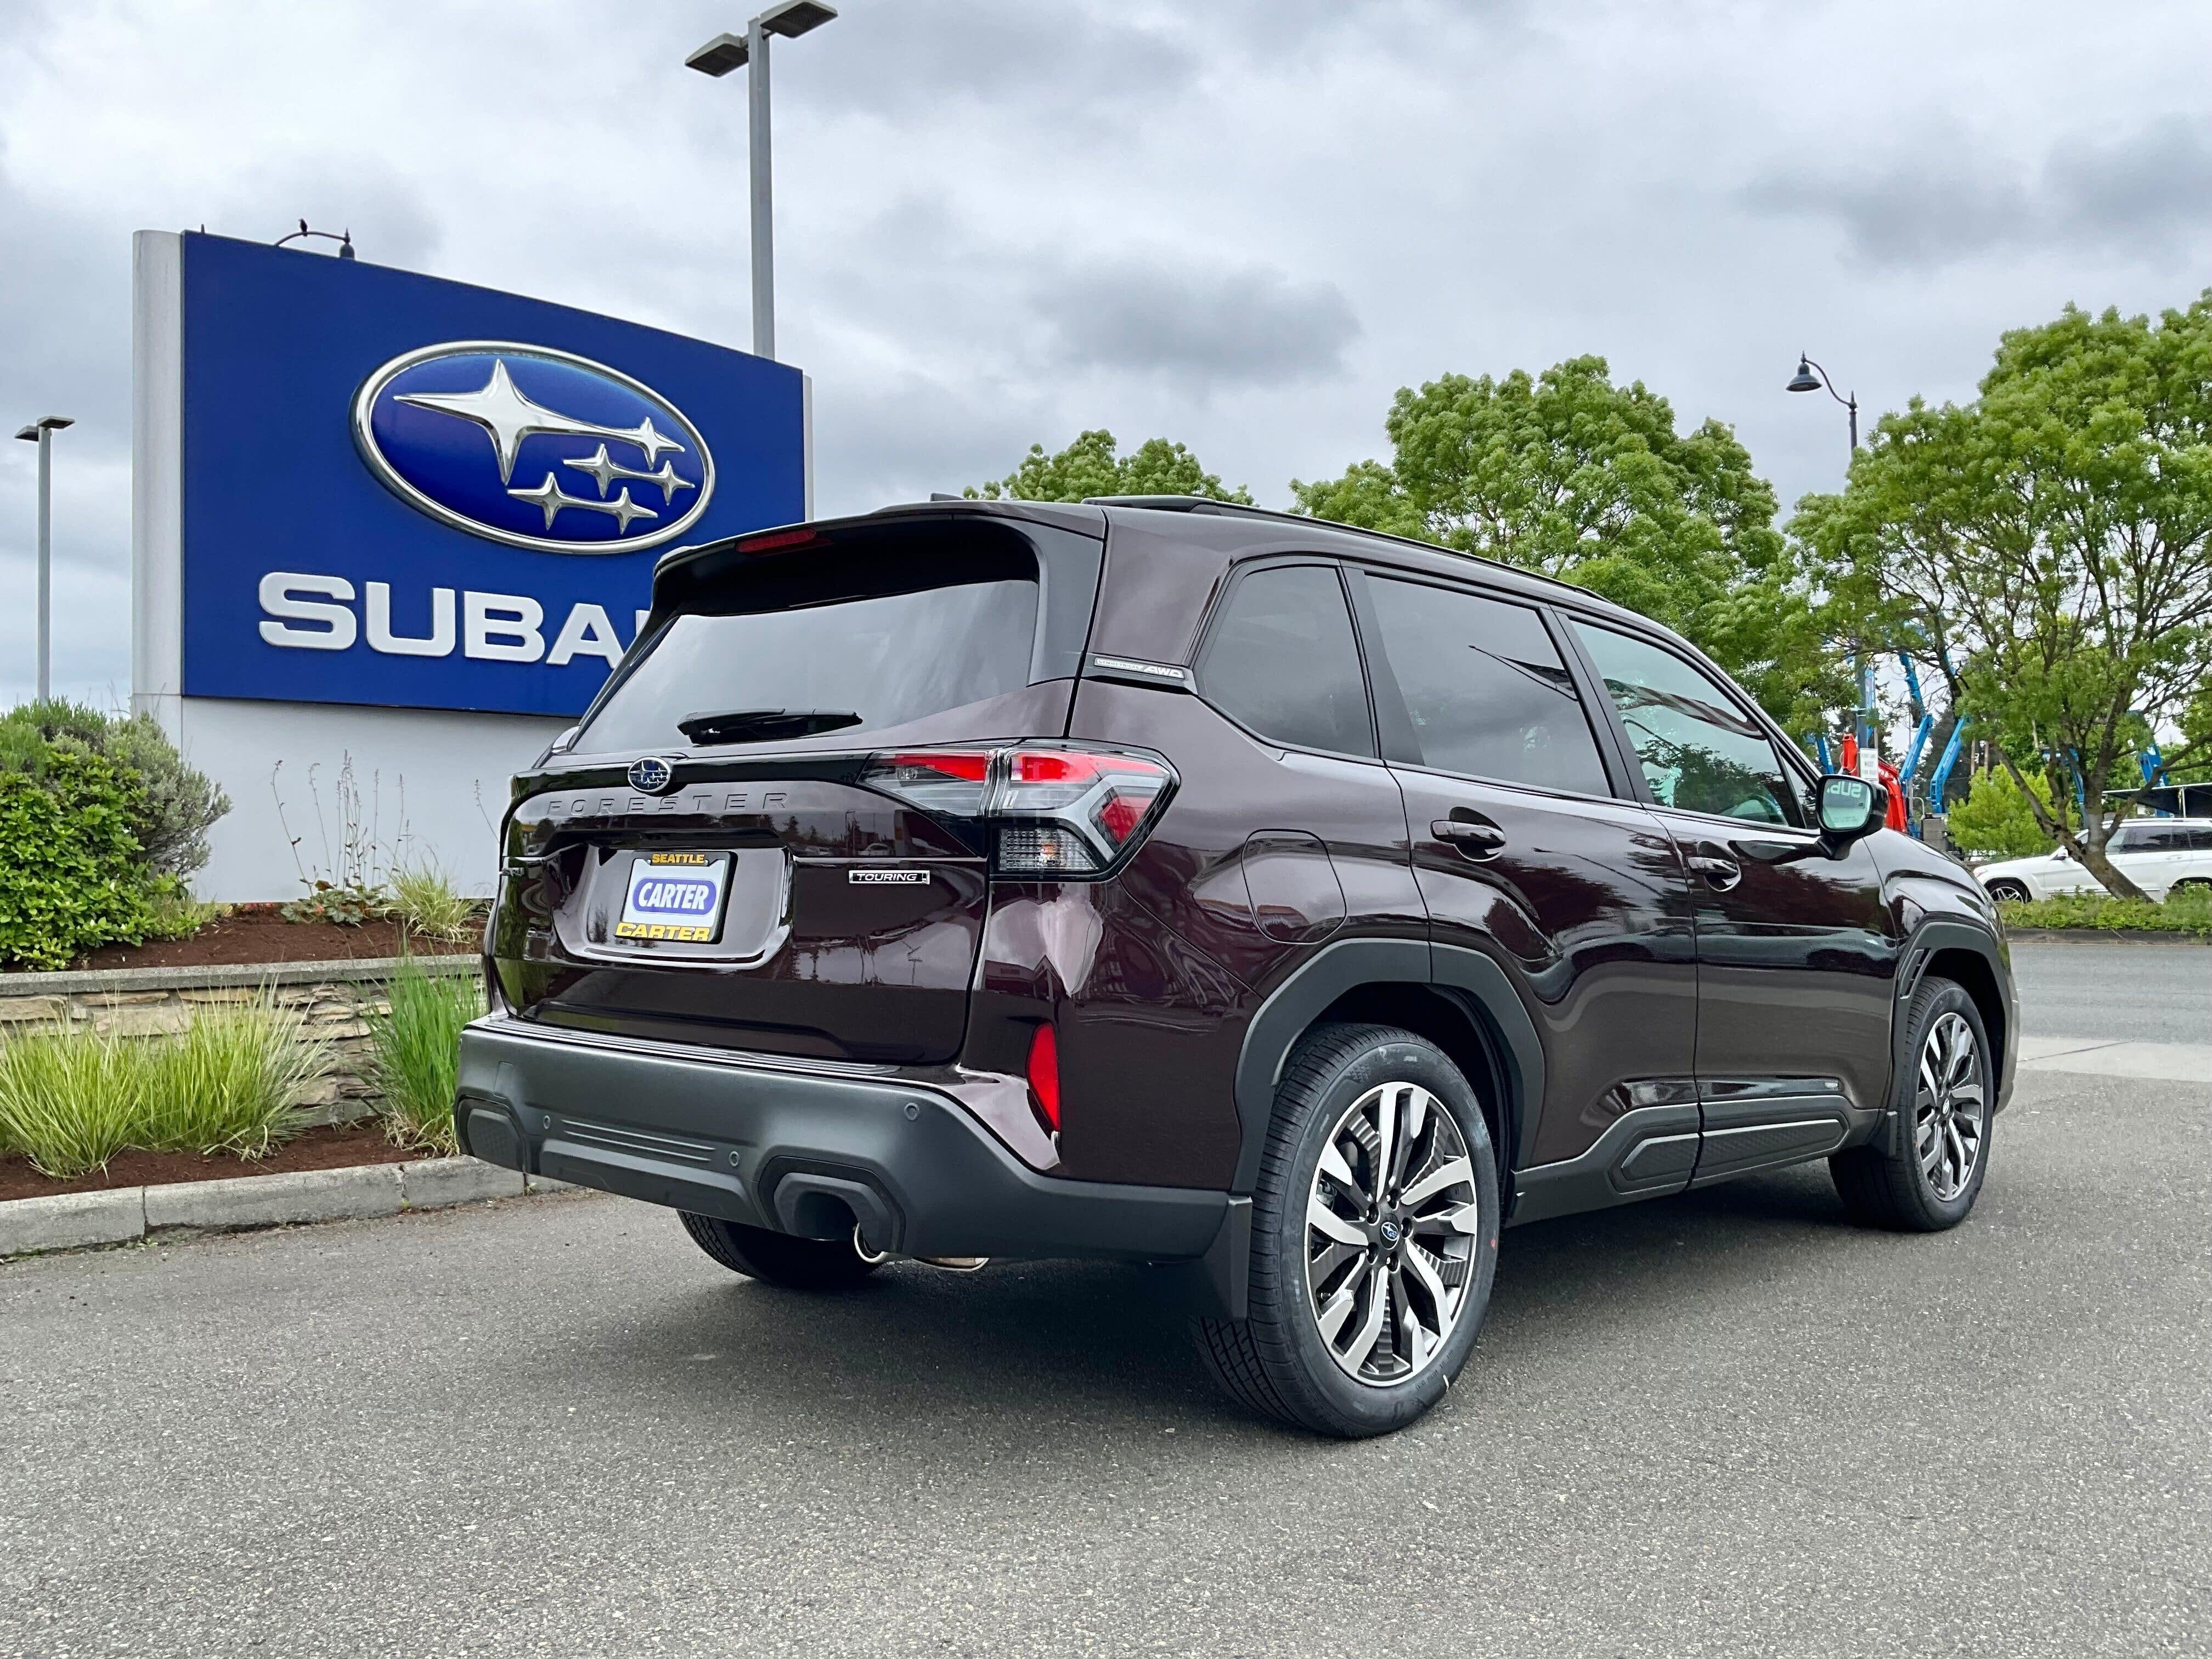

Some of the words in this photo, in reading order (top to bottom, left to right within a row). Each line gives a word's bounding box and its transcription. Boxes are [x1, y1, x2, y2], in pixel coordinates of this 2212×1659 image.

[259, 572, 652, 669] SUBA
[1098, 659, 1139, 669] SYMMETRICAL
[1143, 665, 1184, 679] AWD
[548, 793, 787, 815] FORESTER
[652, 854, 706, 864] SEATTLE
[638, 882, 709, 910] CARTER
[616, 922, 710, 941] CARTER
